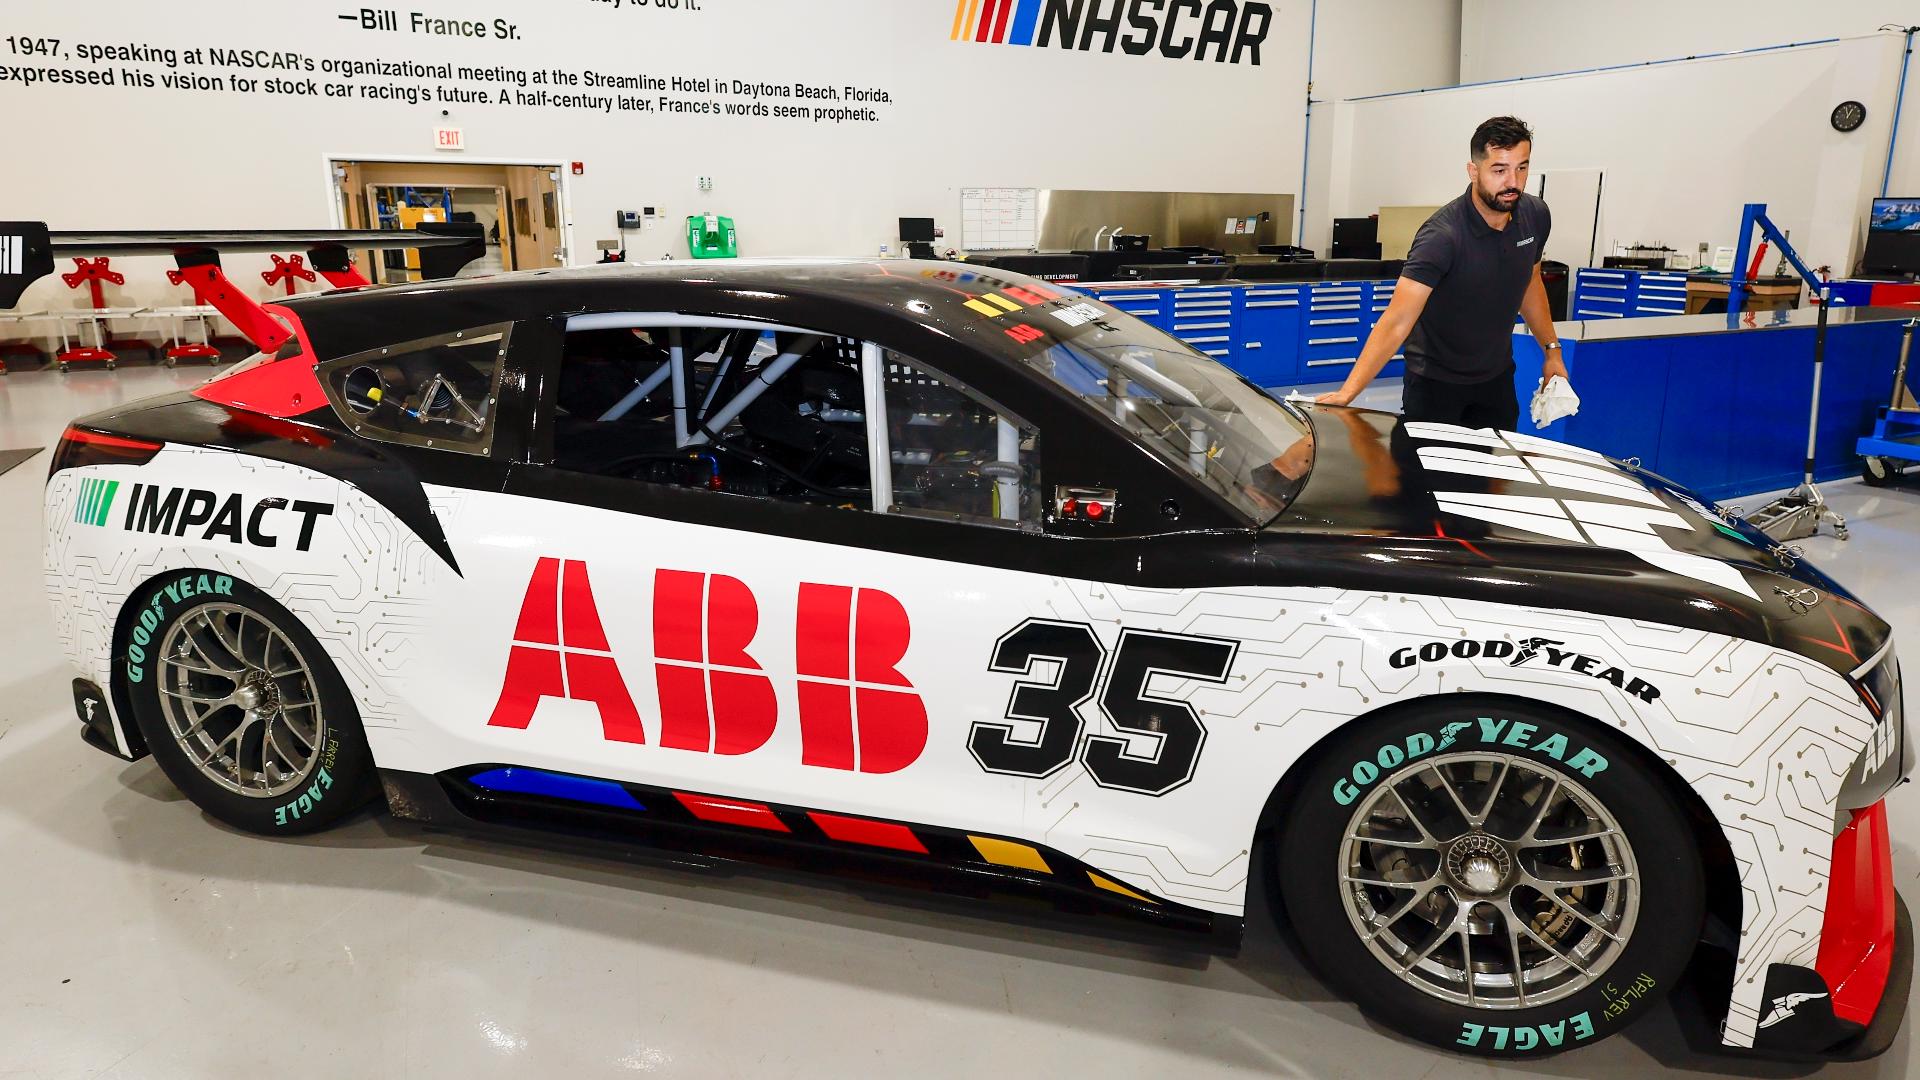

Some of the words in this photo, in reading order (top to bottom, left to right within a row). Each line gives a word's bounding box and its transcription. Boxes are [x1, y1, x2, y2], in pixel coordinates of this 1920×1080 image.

[411, 12, 487, 38] France
[494, 19, 521, 41] Sr.
[1037, 0, 1273, 66] NASCAR
[0, 65, 115, 87] expressed
[122, 69, 155, 88] his
[161, 71, 223, 91] vision
[229, 74, 258, 93] for
[264, 77, 319, 96] stock
[324, 83, 354, 98] car
[360, 83, 432, 105] racing's
[437, 86, 493, 105] future.
[499, 89, 511, 105] A
[516, 90, 613, 114] half-century
[617, 95, 654, 115] later,
[659, 96, 721, 115] France's
[725, 102, 769, 117] words
[773, 106, 810, 119] seem
[814, 107, 879, 124] prophetic.
[6, 36, 69, 60] 1947,
[76, 41, 177, 69] speaking
[183, 48, 203, 65] at
[210, 48, 315, 72] NASCAR's
[321, 58, 452, 80] organizational
[458, 66, 527, 88] meeting
[532, 70, 548, 85] at
[552, 70, 578, 86] the
[583, 71, 666, 91] Streamline
[671, 76, 710, 93] Hotel
[715, 79, 728, 94] in
[732, 80, 791, 100] Daytona
[795, 84, 840, 102] Beach,
[844, 86, 893, 104] Florida,
[439, 130, 460, 145] EXIT
[124, 483, 334, 552] IMPACT
[486, 556, 929, 775] ABB
[966, 617, 1241, 798] 35
[275, 766, 334, 826] EAGLE
[1456, 1010, 1595, 1051] EAGLE
